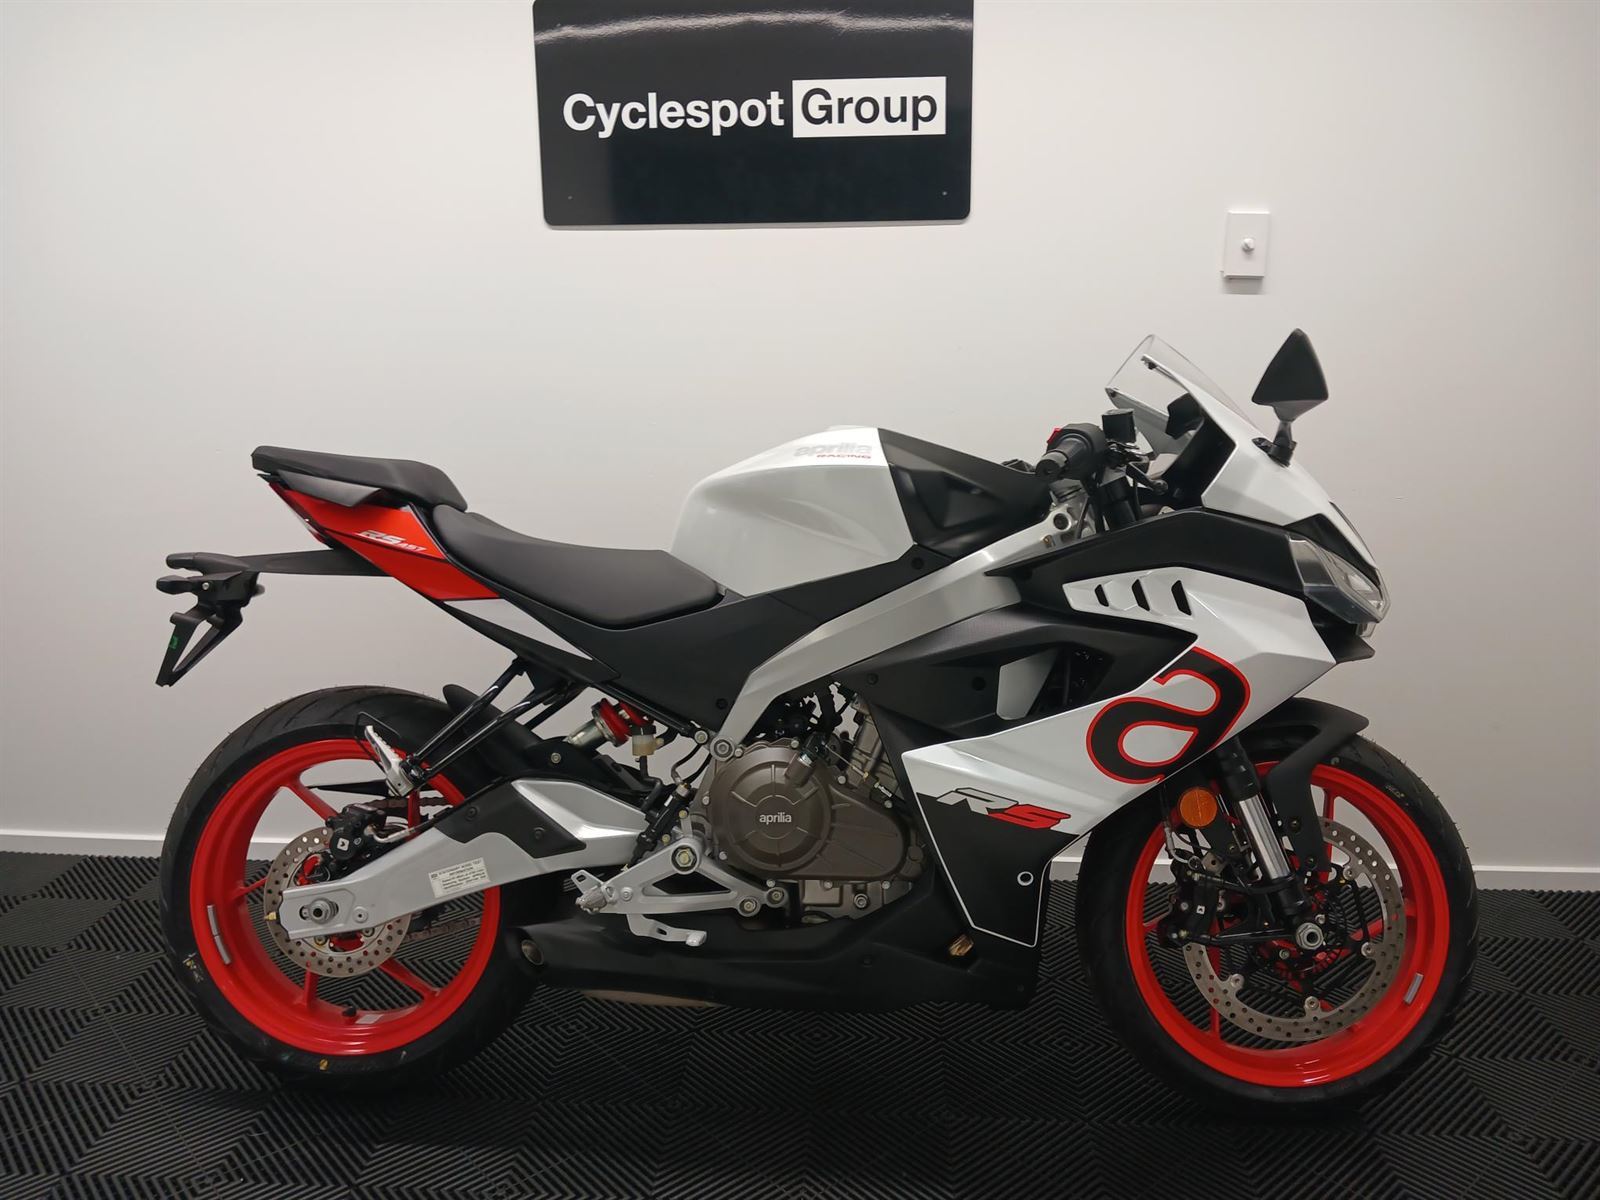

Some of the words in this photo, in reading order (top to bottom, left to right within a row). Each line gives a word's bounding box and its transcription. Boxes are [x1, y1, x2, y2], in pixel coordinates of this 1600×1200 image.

[562, 91, 785, 139] Cyclespot
[800, 87, 938, 132] Group
[759, 811, 793, 825] aprilia
[936, 787, 1072, 830] RS
